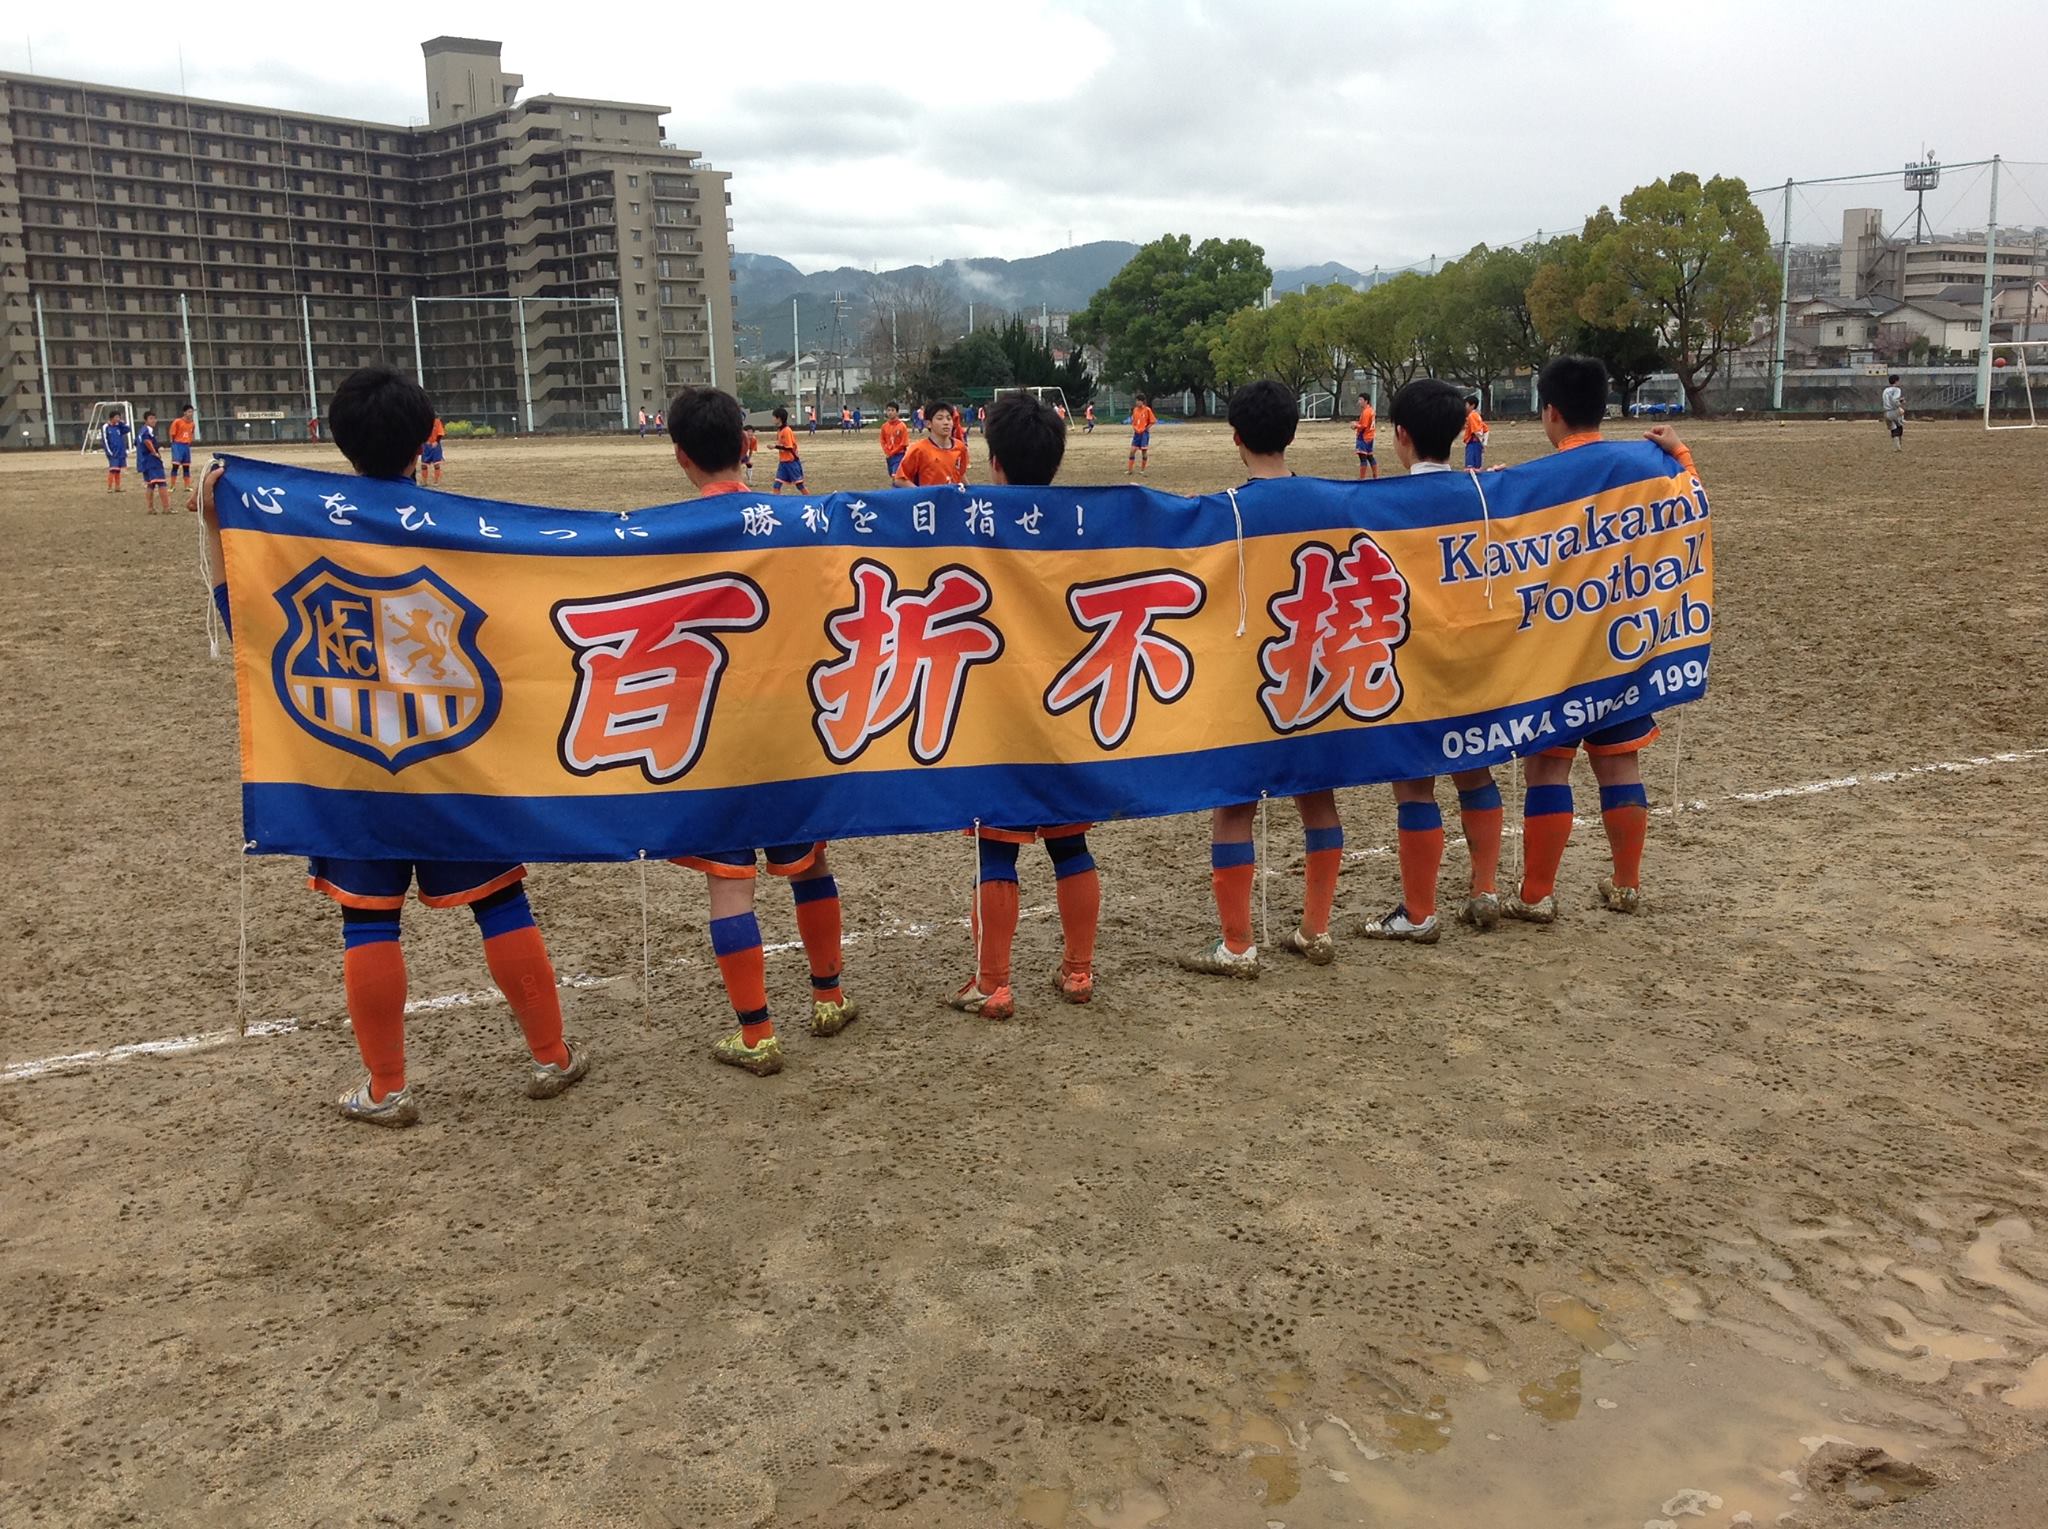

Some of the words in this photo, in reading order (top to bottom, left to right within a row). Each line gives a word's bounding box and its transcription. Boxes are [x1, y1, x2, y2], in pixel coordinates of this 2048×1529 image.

[241, 486, 649, 540] 心をひとつに
[1438, 478, 1711, 584] Kawakami
[1515, 532, 1706, 630] Football
[550, 532, 1410, 785] 百折不撓
[1607, 591, 1712, 663] Club
[1442, 711, 1556, 759] OSAKA
[1562, 684, 1640, 728] Since
